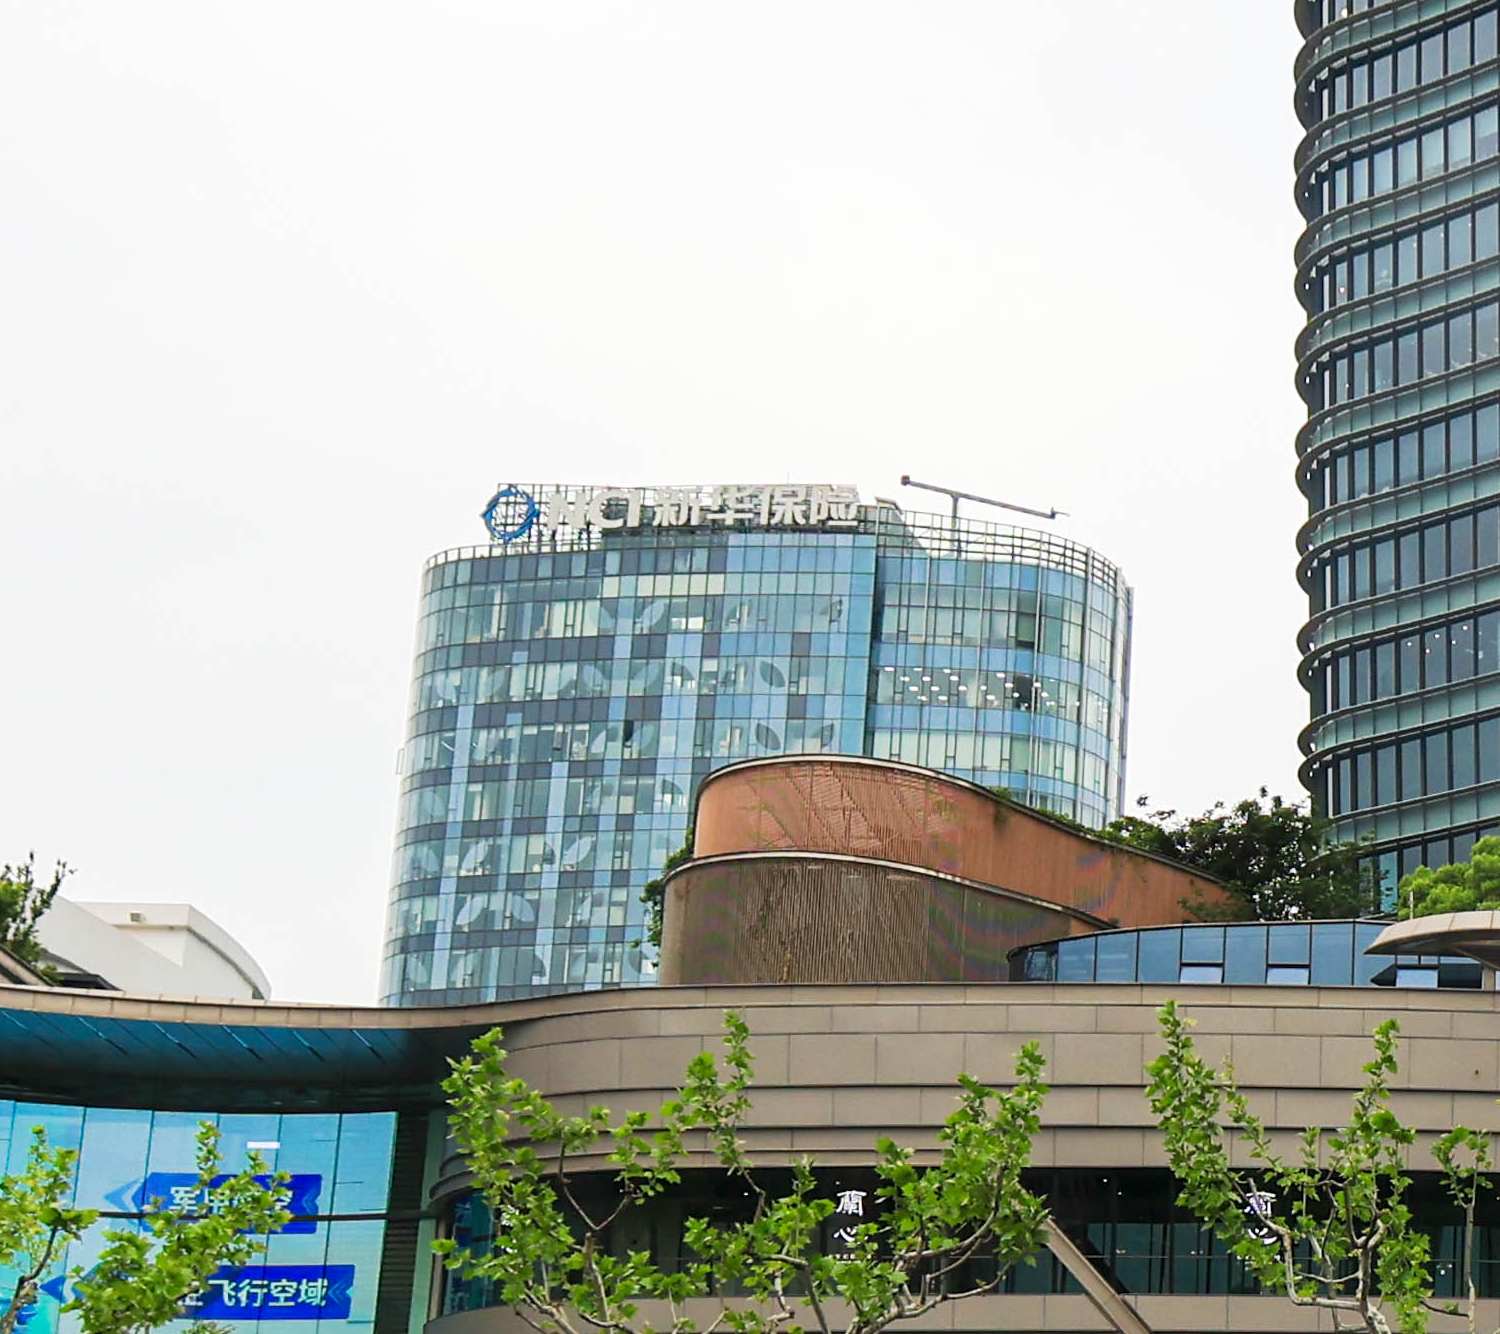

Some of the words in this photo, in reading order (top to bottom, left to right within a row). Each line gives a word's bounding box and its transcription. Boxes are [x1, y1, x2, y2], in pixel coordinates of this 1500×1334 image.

[547, 488, 641, 529] NCI
[653, 484, 859, 527] 新华保险
